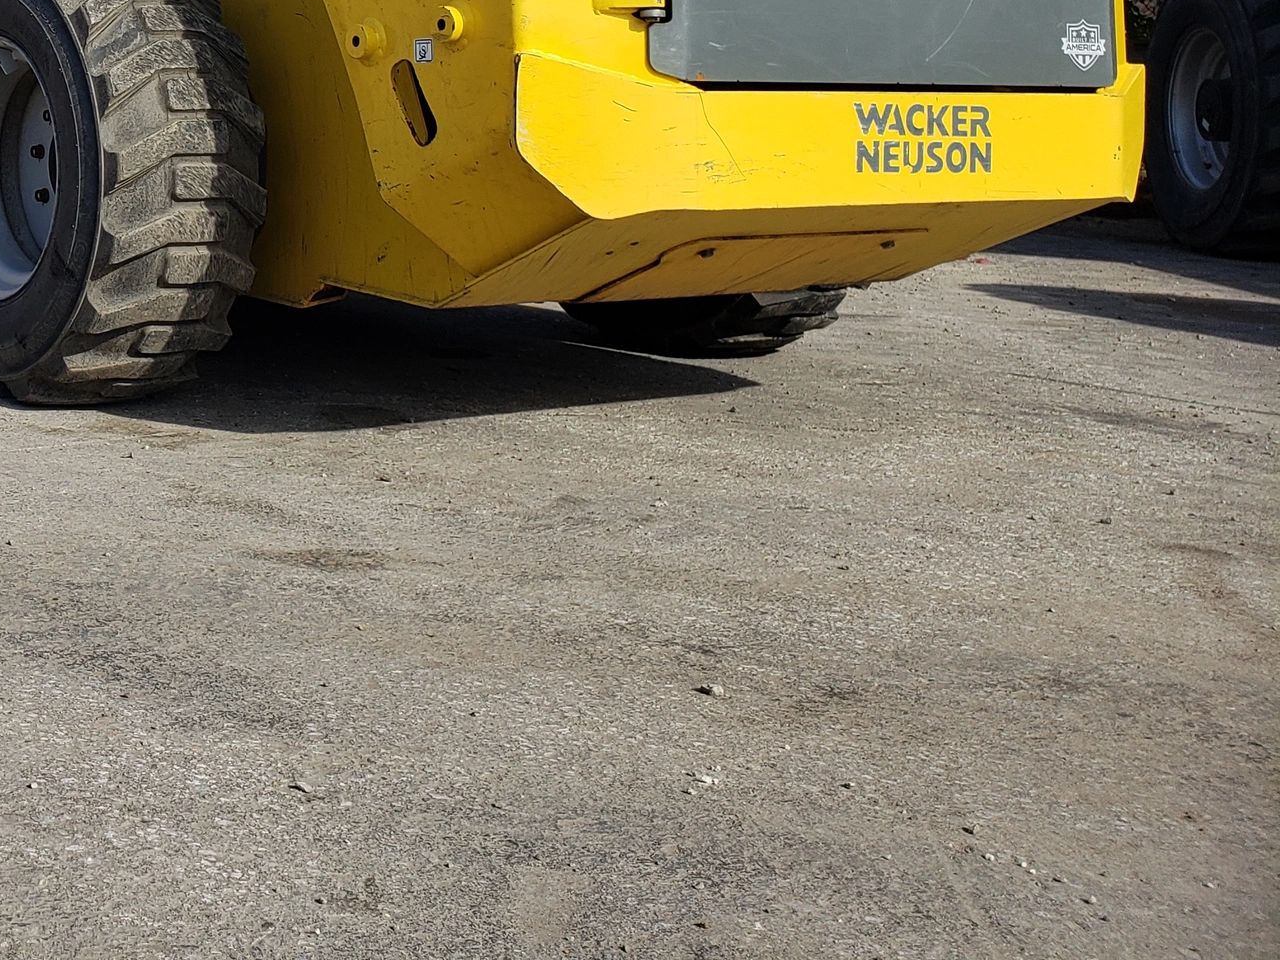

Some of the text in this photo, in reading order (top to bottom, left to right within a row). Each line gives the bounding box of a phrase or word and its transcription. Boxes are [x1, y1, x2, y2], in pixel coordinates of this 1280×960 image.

[1066, 43, 1102, 52] AMERICA
[854, 103, 992, 137] WACKER
[856, 141, 992, 174] NEUSON
